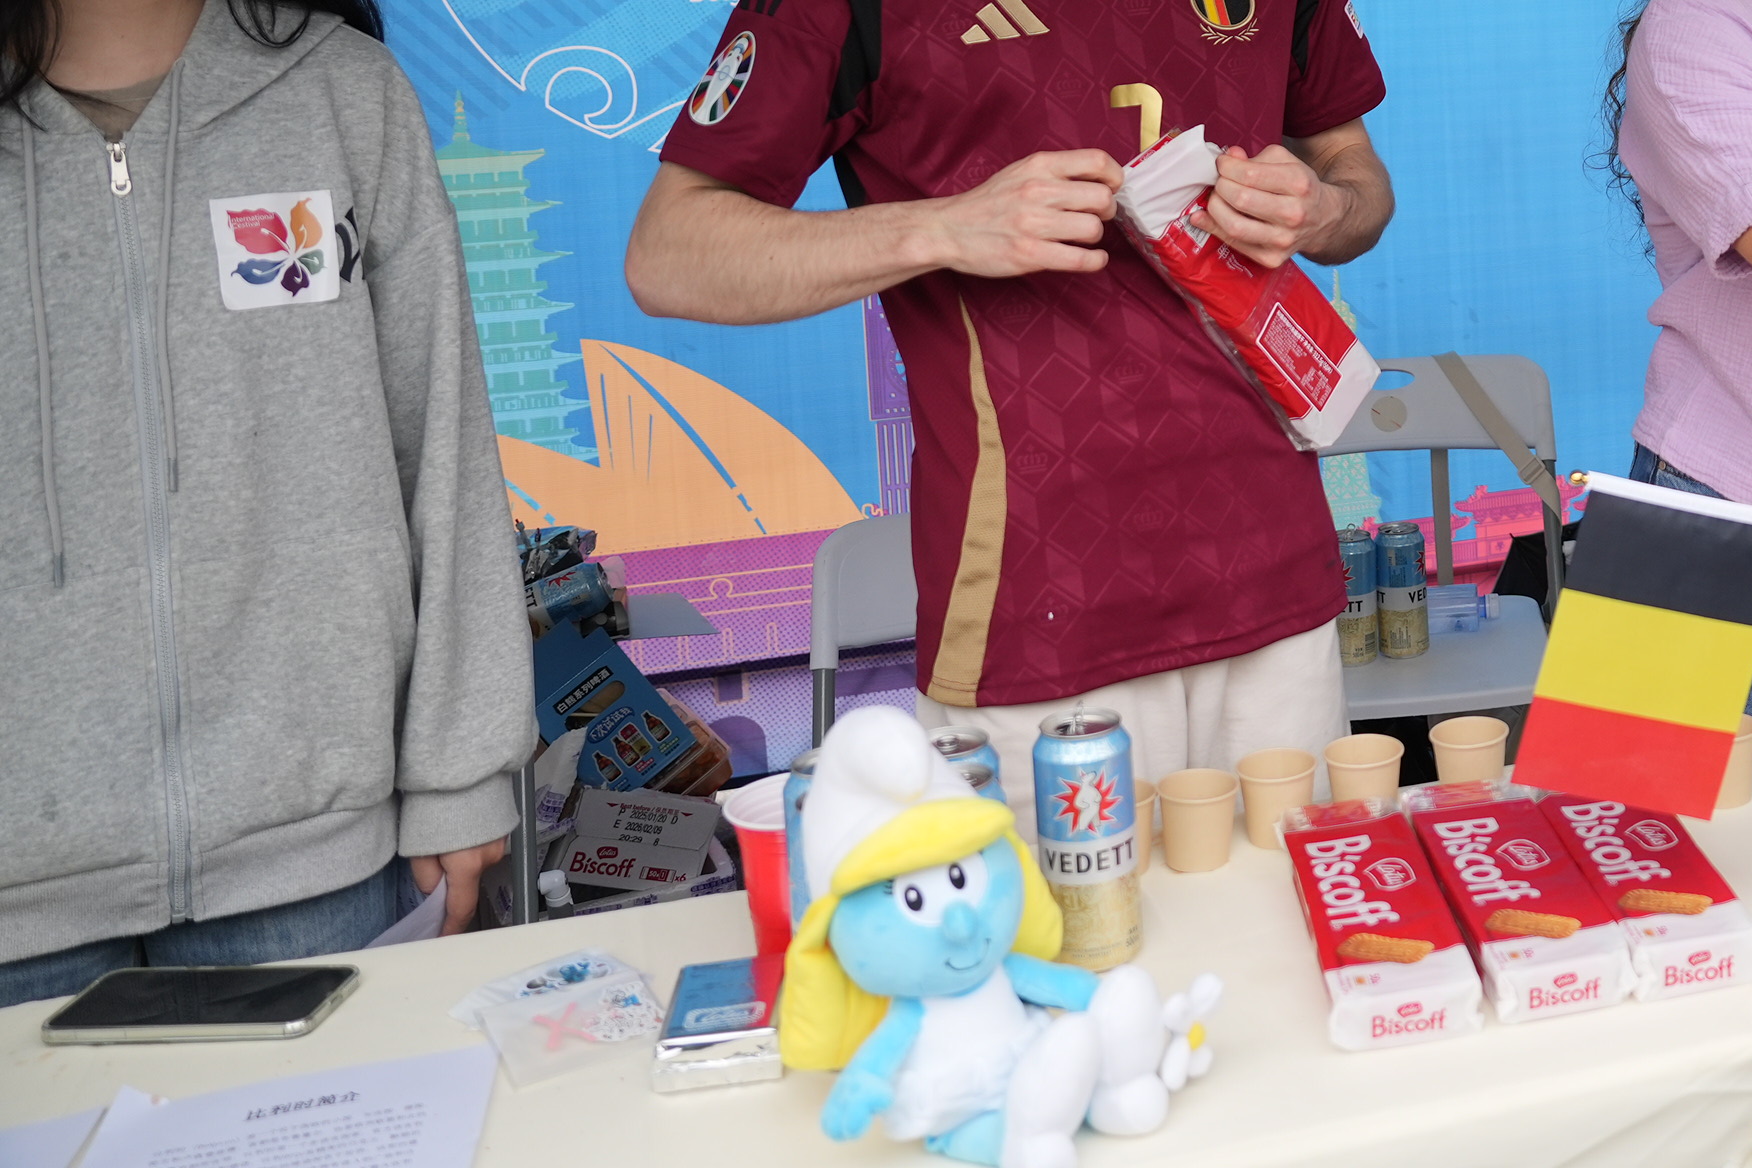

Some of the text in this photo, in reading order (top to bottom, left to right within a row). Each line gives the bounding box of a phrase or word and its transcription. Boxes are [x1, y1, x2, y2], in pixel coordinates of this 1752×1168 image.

[618, 808, 679, 825] P 2025/01/20 D
[633, 804, 650, 812] before
[613, 819, 621, 829] E
[1636, 824, 1667, 846] Lotus
[599, 847, 616, 857] Lotus
[1045, 836, 1134, 874] VEDETT
[1560, 800, 1672, 882] Biscoff
[569, 851, 637, 878] Biscoff
[1432, 816, 1542, 903] Biscoff
[1304, 833, 1401, 927] Biscoff
[1664, 954, 1735, 987] Biscoff
[1529, 977, 1601, 1009] Biscoff
[1371, 1008, 1447, 1038] Biscoff
